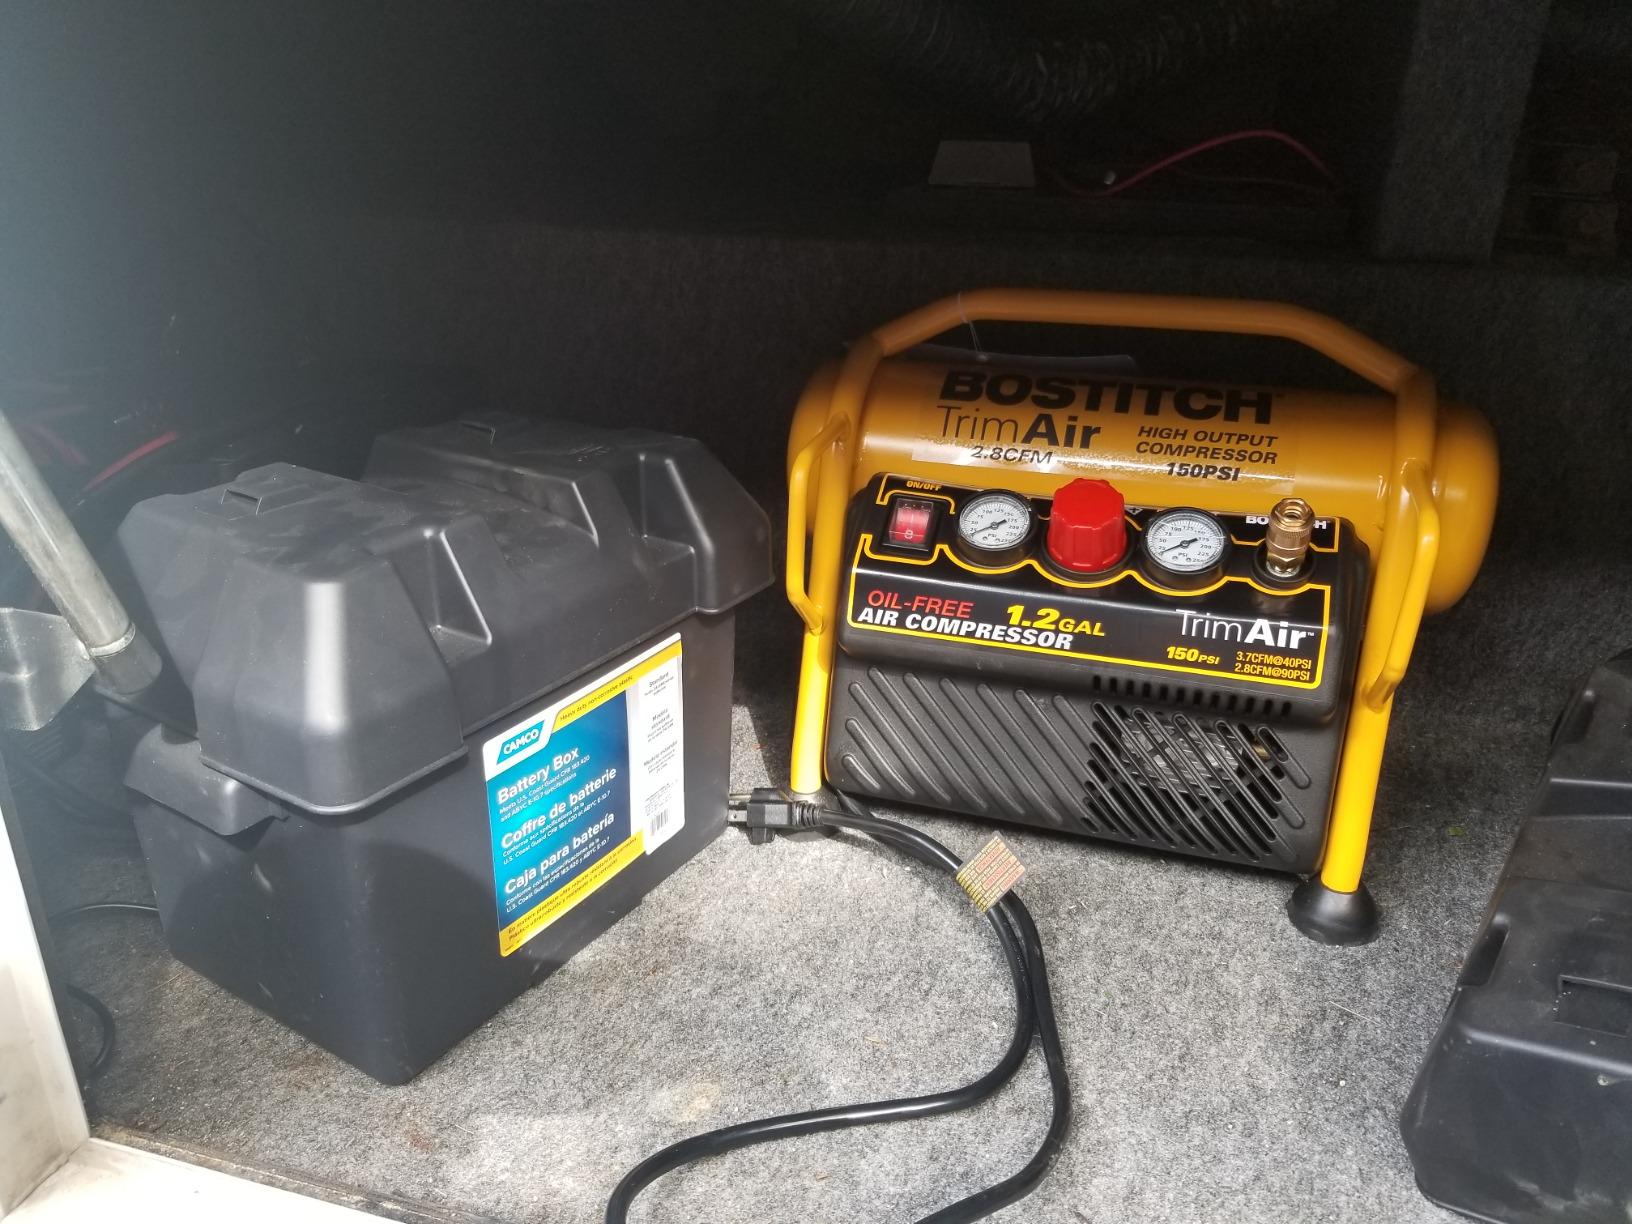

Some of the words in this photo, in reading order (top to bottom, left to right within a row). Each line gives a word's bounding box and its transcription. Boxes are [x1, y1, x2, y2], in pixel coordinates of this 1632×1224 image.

[939, 371, 1273, 424] BOSTITCH
[937, 405, 1102, 448] TrimAir
[1137, 426, 1188, 441] HIGH
[1194, 430, 1278, 447] OUTPUT
[970, 445, 1053, 465] 2.8CFM
[1136, 441, 1278, 464] COMPRESSOR
[906, 481, 942, 491] ON/OFF
[1166, 462, 1241, 481] 150PSI
[868, 590, 974, 619] OIL-FREE
[857, 607, 900, 627] AIR
[905, 613, 1074, 650] COMPRESSOR
[1234, 663, 1311, 681] 2.8CFM@90PSI
[1236, 651, 1312, 669] 3.7CFM@40PSI
[503, 726, 539, 755] CAMCO
[497, 765, 549, 805] Battery
[553, 747, 579, 771] Box
[500, 813, 546, 851] Coffre
[548, 800, 566, 819] de
[569, 767, 616, 806] batterie
[504, 866, 536, 895] Caja
[540, 843, 569, 874] para
[572, 812, 614, 849] batería
